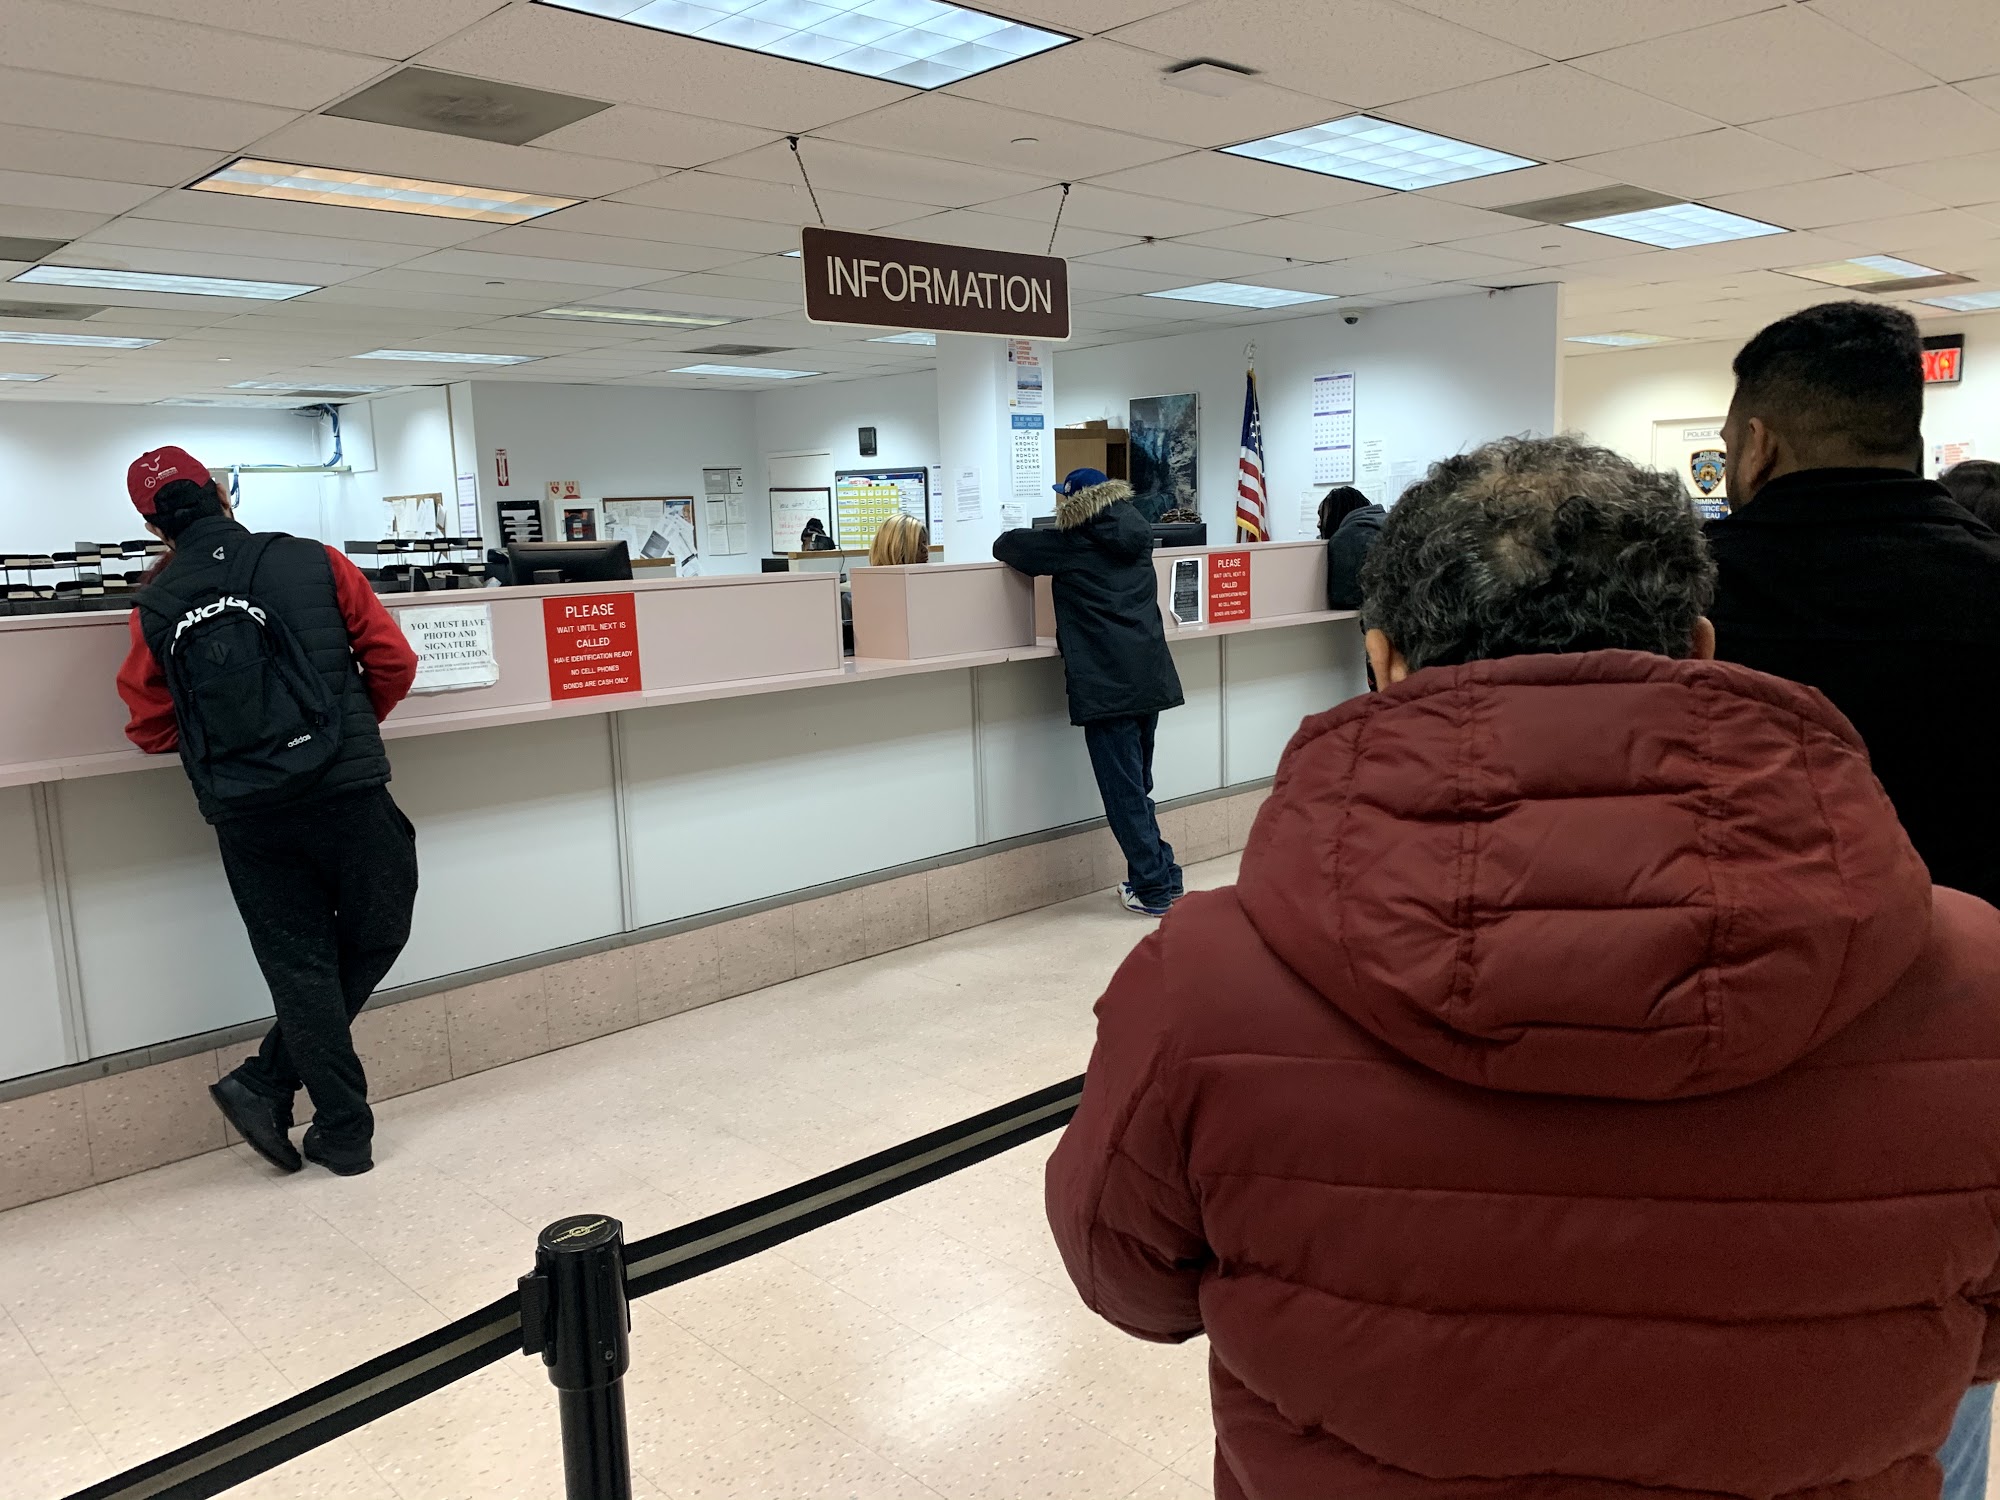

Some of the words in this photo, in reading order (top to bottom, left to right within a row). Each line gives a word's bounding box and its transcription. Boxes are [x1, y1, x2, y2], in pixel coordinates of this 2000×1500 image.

[826, 255, 1052, 314] INFORMATION
[1686, 430, 1712, 438] POLICE
[1217, 558, 1241, 568] PLEASE
[1221, 581, 1238, 589] CALLED
[565, 603, 615, 618] PLEASE
[171, 596, 267, 656] didas
[411, 622, 431, 631] YOU
[434, 620, 460, 629] MUST
[461, 619, 486, 628] HAVE
[556, 625, 574, 634] WAIT
[577, 623, 597, 633] UNTIL
[600, 622, 617, 631] NEXT
[619, 621, 626, 629] IS
[423, 631, 456, 640] PHOTO
[458, 630, 477, 638] AND
[424, 640, 478, 651] SIGNATURE
[576, 637, 610, 648] CALLED
[417, 649, 488, 661] DENTIFICATION
[554, 656, 570, 664] HAVE
[571, 652, 613, 663] IDENTIFICATION
[613, 650, 633, 659] READY
[581, 667, 596, 675] CELL
[597, 664, 620, 673] PHONES
[563, 682, 584, 690] BONDS
[598, 679, 613, 687] CASH
[614, 677, 629, 685] ONLY
[287, 734, 311, 748] adidas
